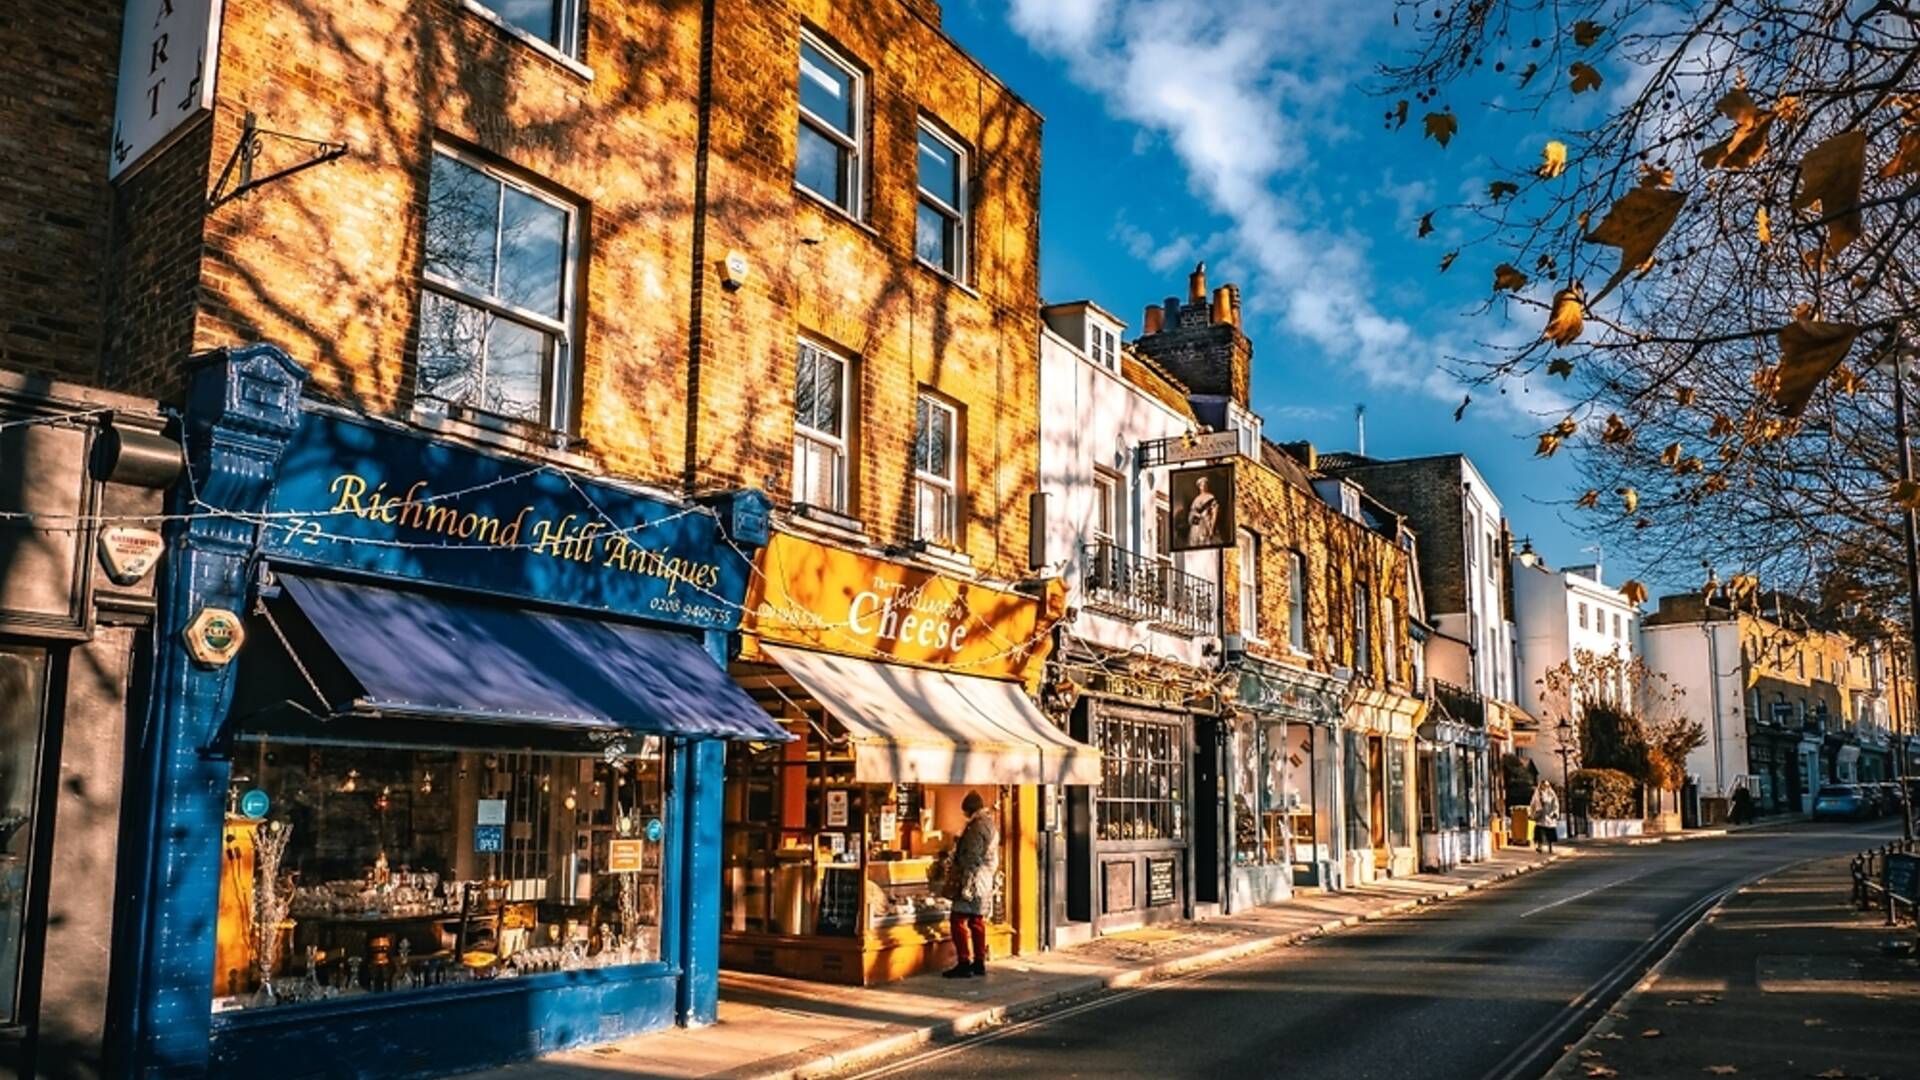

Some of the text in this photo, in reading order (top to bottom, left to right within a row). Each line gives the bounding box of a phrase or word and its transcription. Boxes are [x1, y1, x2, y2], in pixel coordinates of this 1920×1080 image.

[283, 517, 322, 545] 72
[329, 474, 720, 596] Richmond Hill Antiques
[650, 597, 681, 613] 0208
[848, 591, 967, 652] Cheese
